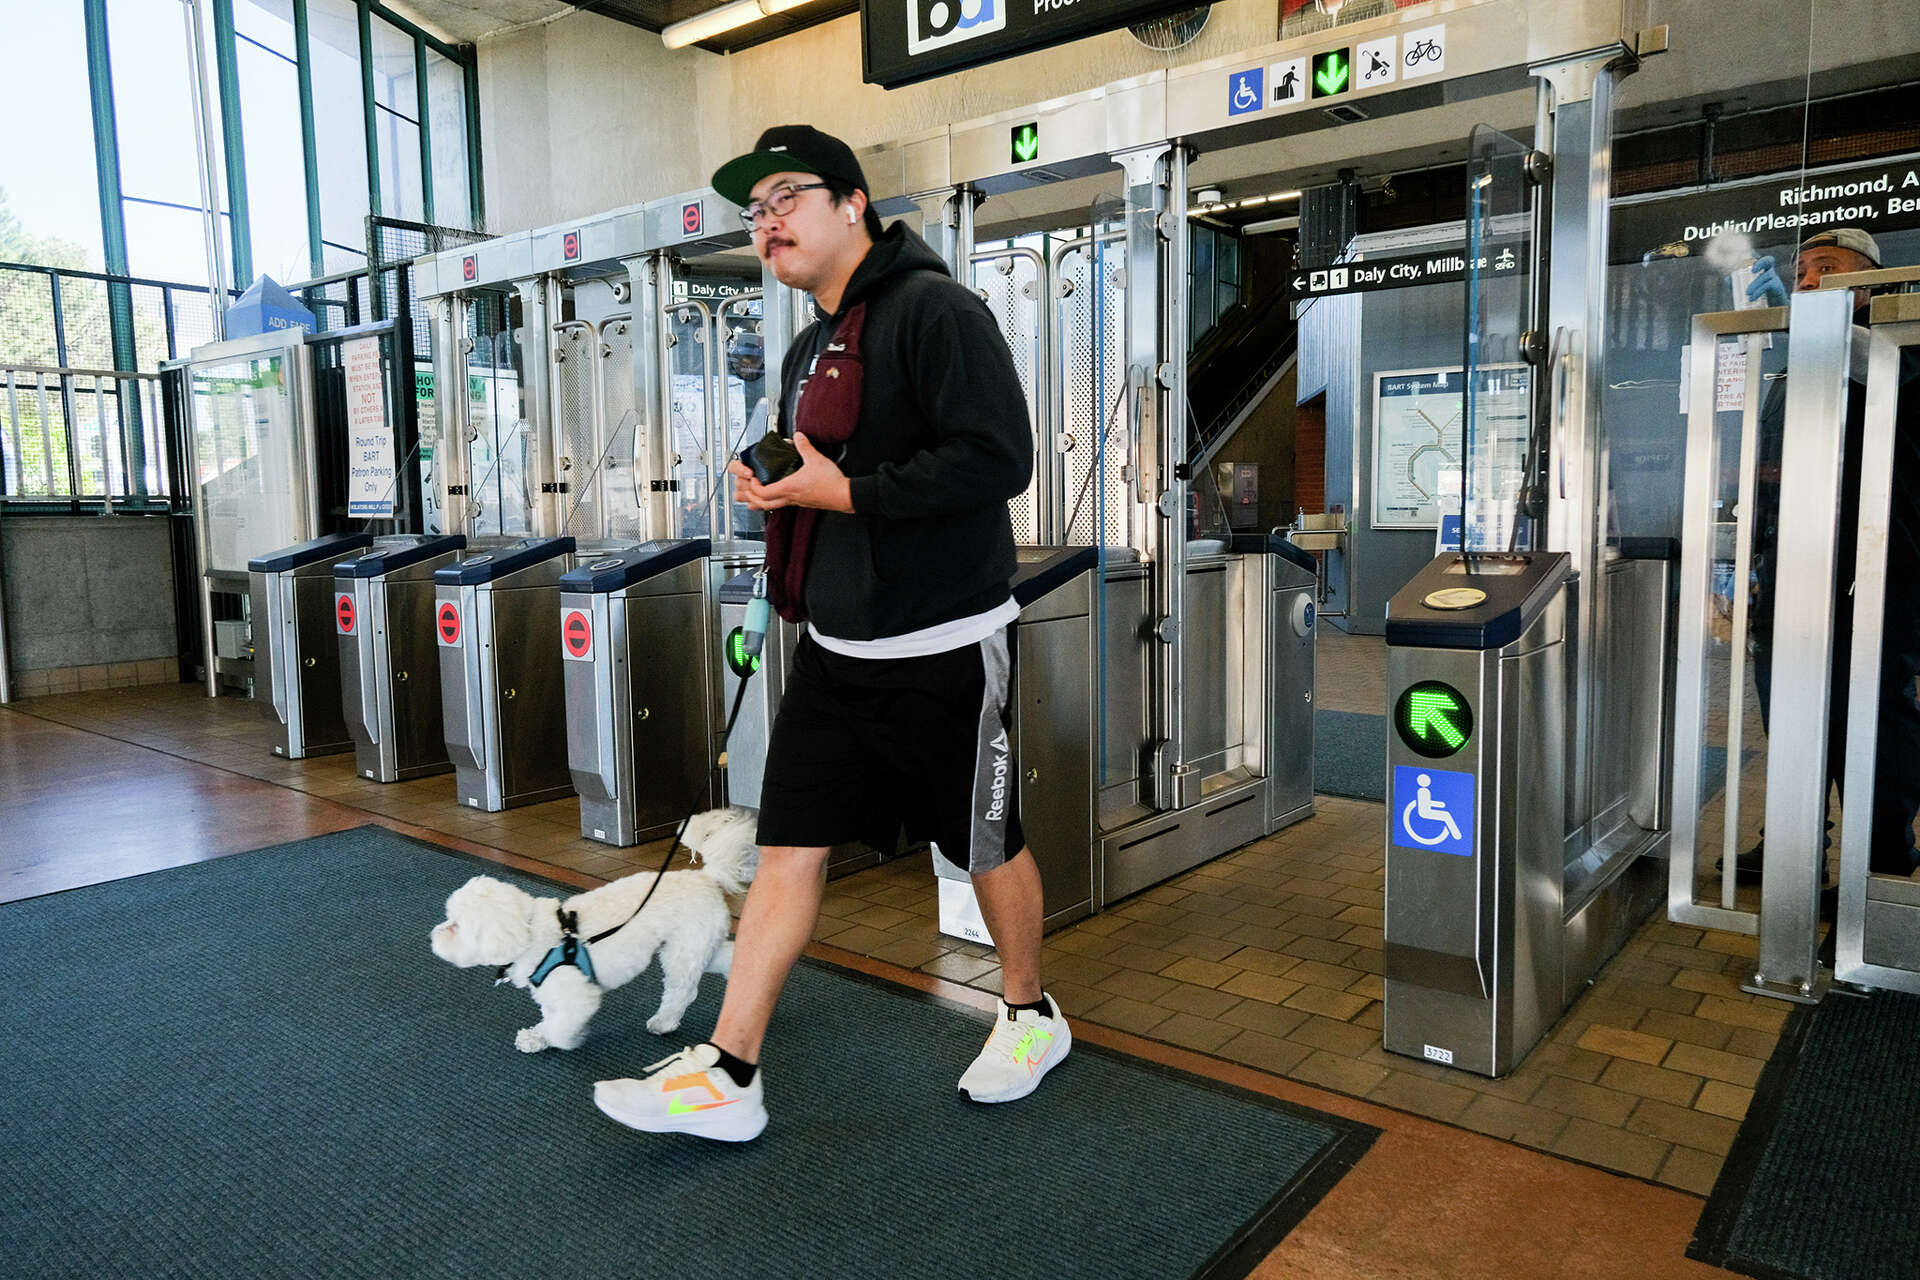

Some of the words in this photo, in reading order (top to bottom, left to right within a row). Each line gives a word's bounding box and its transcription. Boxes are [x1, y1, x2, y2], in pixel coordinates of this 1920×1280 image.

[1780, 174, 1894, 206] Richmond,
[1683, 204, 1879, 241] Dublin/Pleasanton,
[1335, 271, 1343, 286] 1
[1354, 267, 1386, 283] Daly
[1390, 264, 1422, 279] City,
[1426, 257, 1487, 275] Millbae
[692, 284, 716, 297] Daly
[268, 316, 288, 329] ADD
[290, 320, 311, 334] FARE
[1387, 383, 1405, 391] BART
[1406, 382, 1432, 392] System
[361, 392, 376, 405] NOT
[355, 436, 374, 448] Round
[375, 435, 387, 448] Trip
[363, 450, 380, 462] BART
[351, 466, 370, 478] Patron
[370, 466, 392, 479] Parking
[364, 481, 377, 494] Only
[984, 753, 1008, 821] Reebok
[1426, 1047, 1451, 1061] 3722
